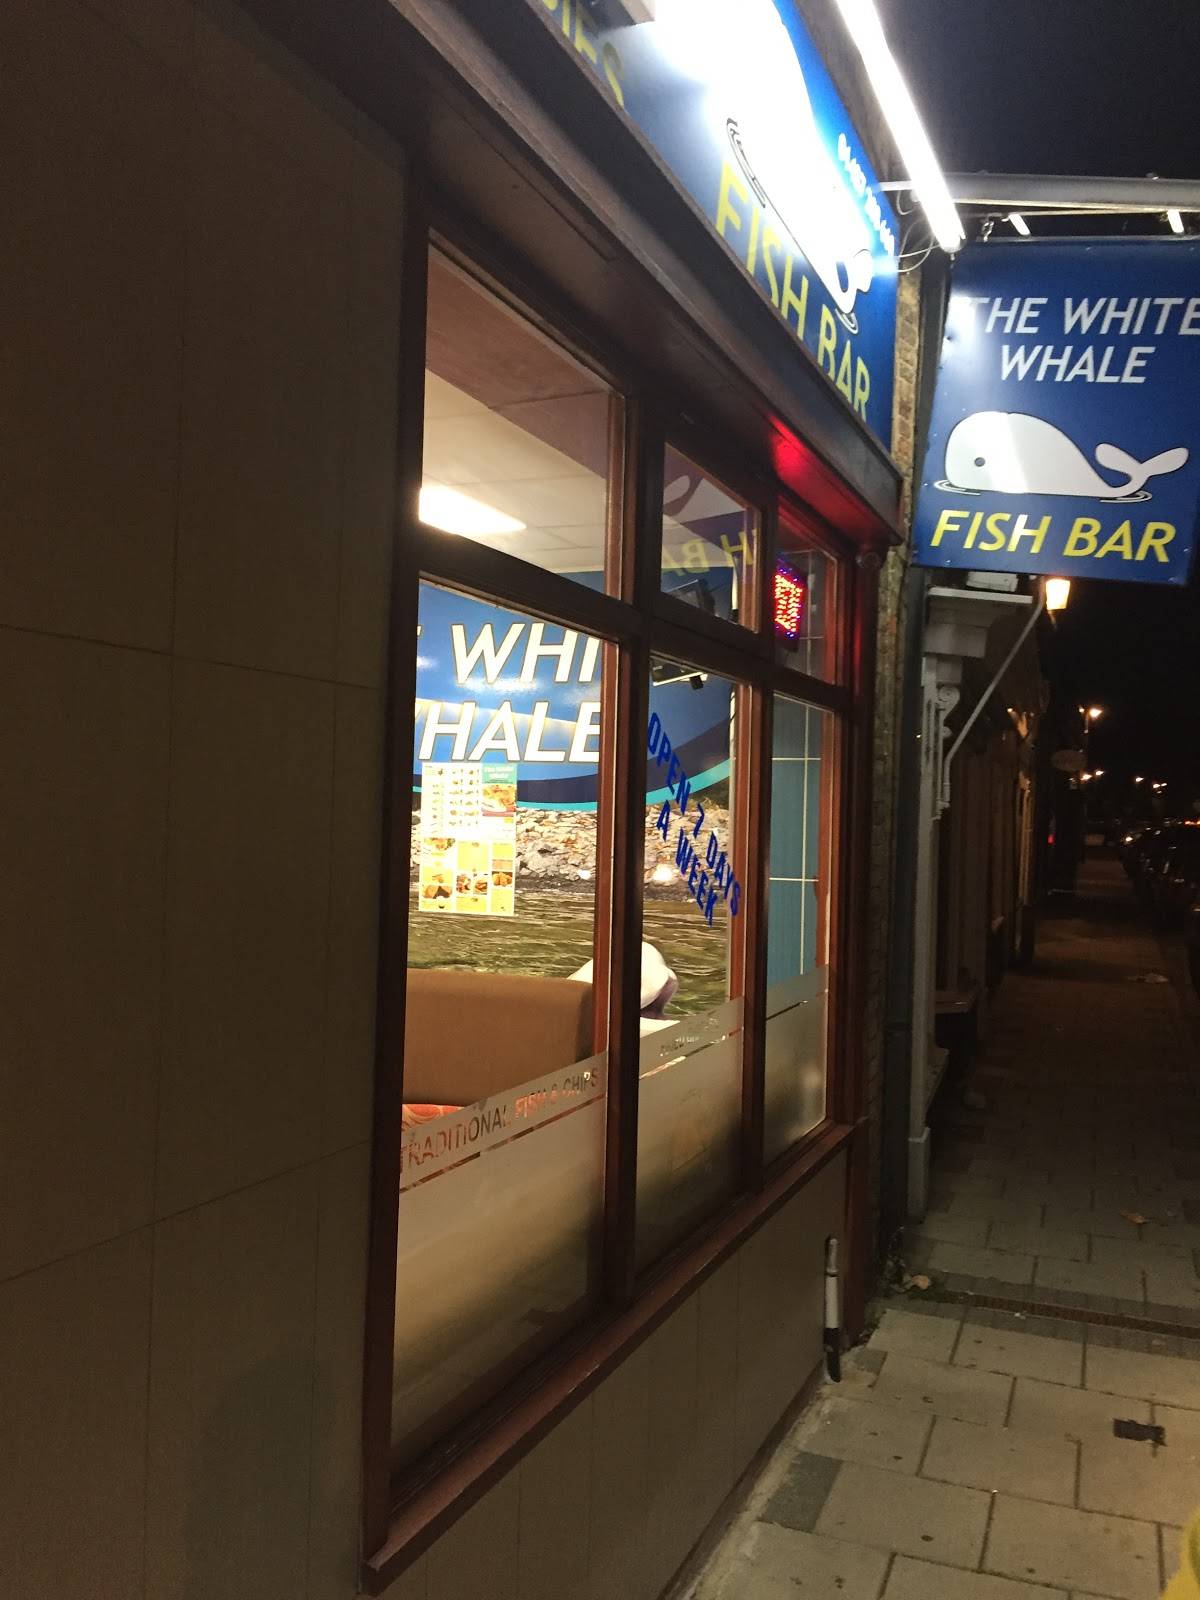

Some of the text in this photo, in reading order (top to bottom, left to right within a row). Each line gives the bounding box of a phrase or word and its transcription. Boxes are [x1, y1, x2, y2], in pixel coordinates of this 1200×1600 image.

[713, 161, 809, 341] FISH
[817, 303, 871, 424] BAR
[1063, 297, 1200, 336] WHITE
[1001, 344, 1156, 384] WHALE
[930, 509, 1177, 563] FISH BAR
[415, 700, 600, 763] HALE
[647, 711, 691, 815] OPEN
[705, 831, 741, 917] DAYS
[656, 799, 719, 929] A WEEK
[562, 1067, 599, 1097] CHIPS
